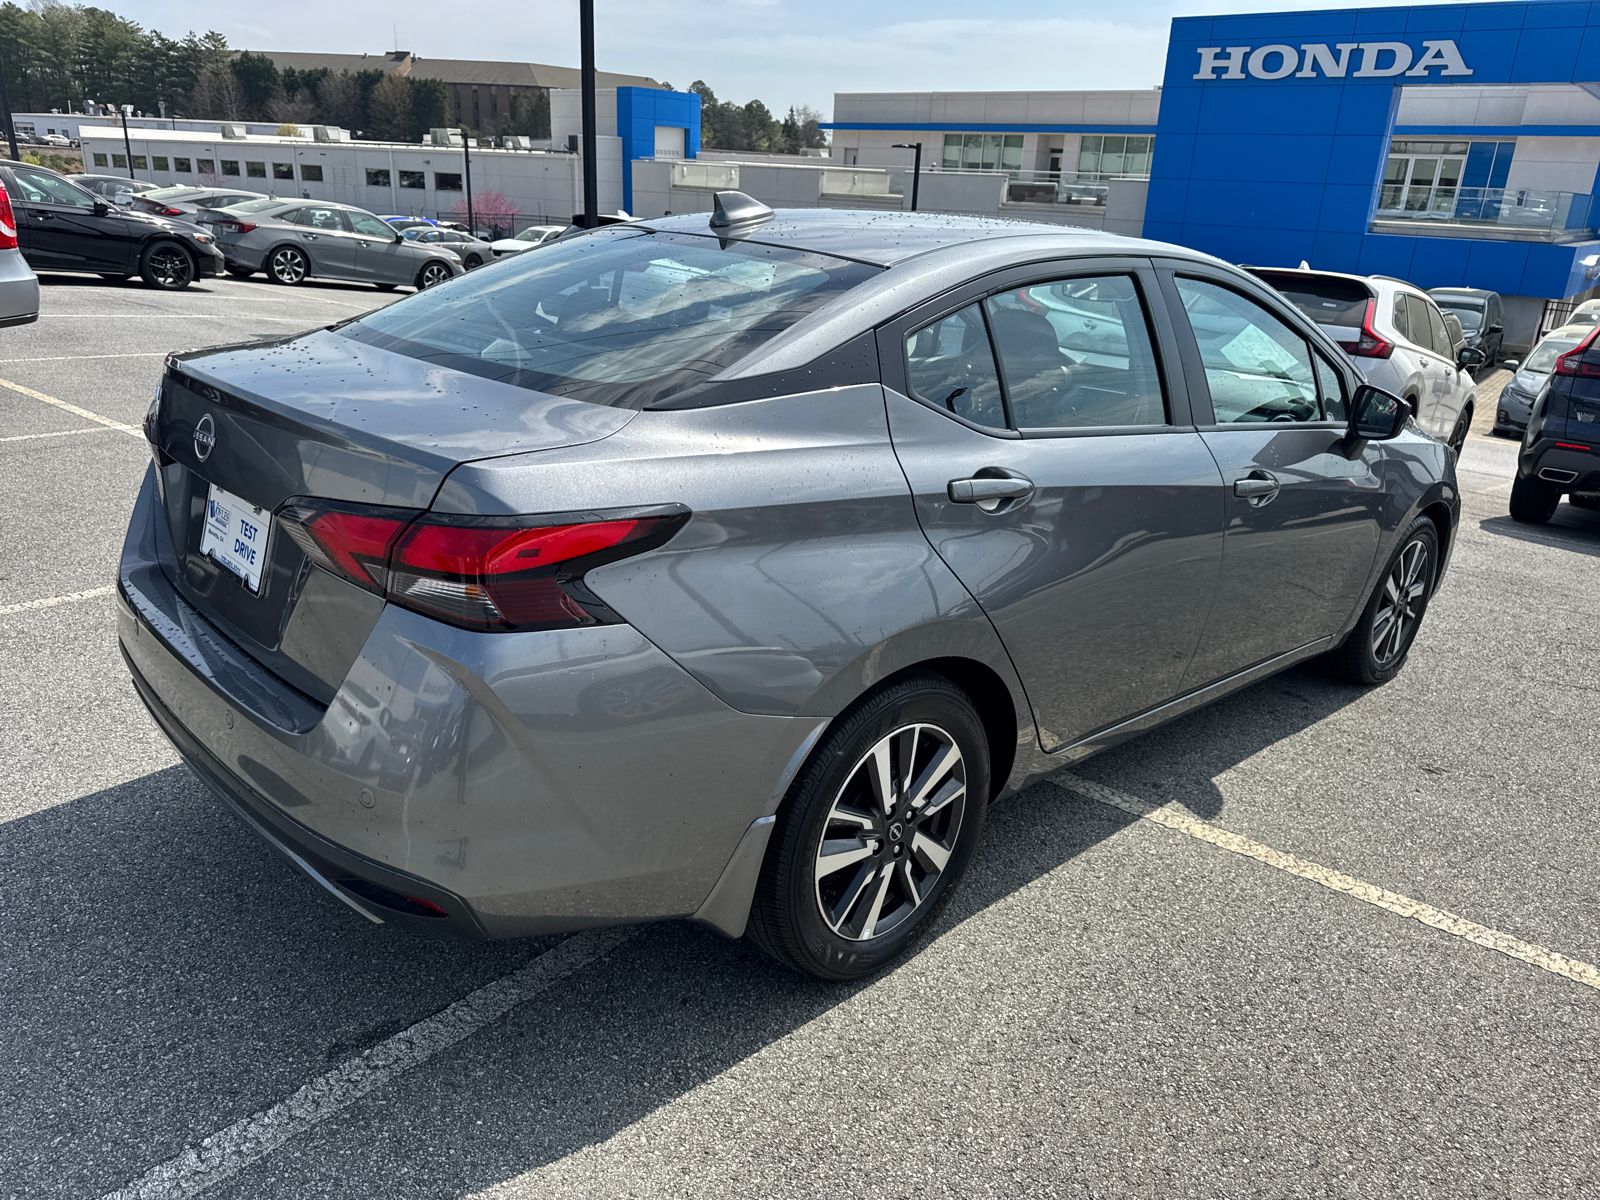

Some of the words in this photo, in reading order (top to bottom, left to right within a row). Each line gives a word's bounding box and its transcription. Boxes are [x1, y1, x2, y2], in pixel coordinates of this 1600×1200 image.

[1192, 40, 1474, 80] HONDA
[240, 519, 258, 543] TEST
[234, 538, 256, 566] DRIVE
